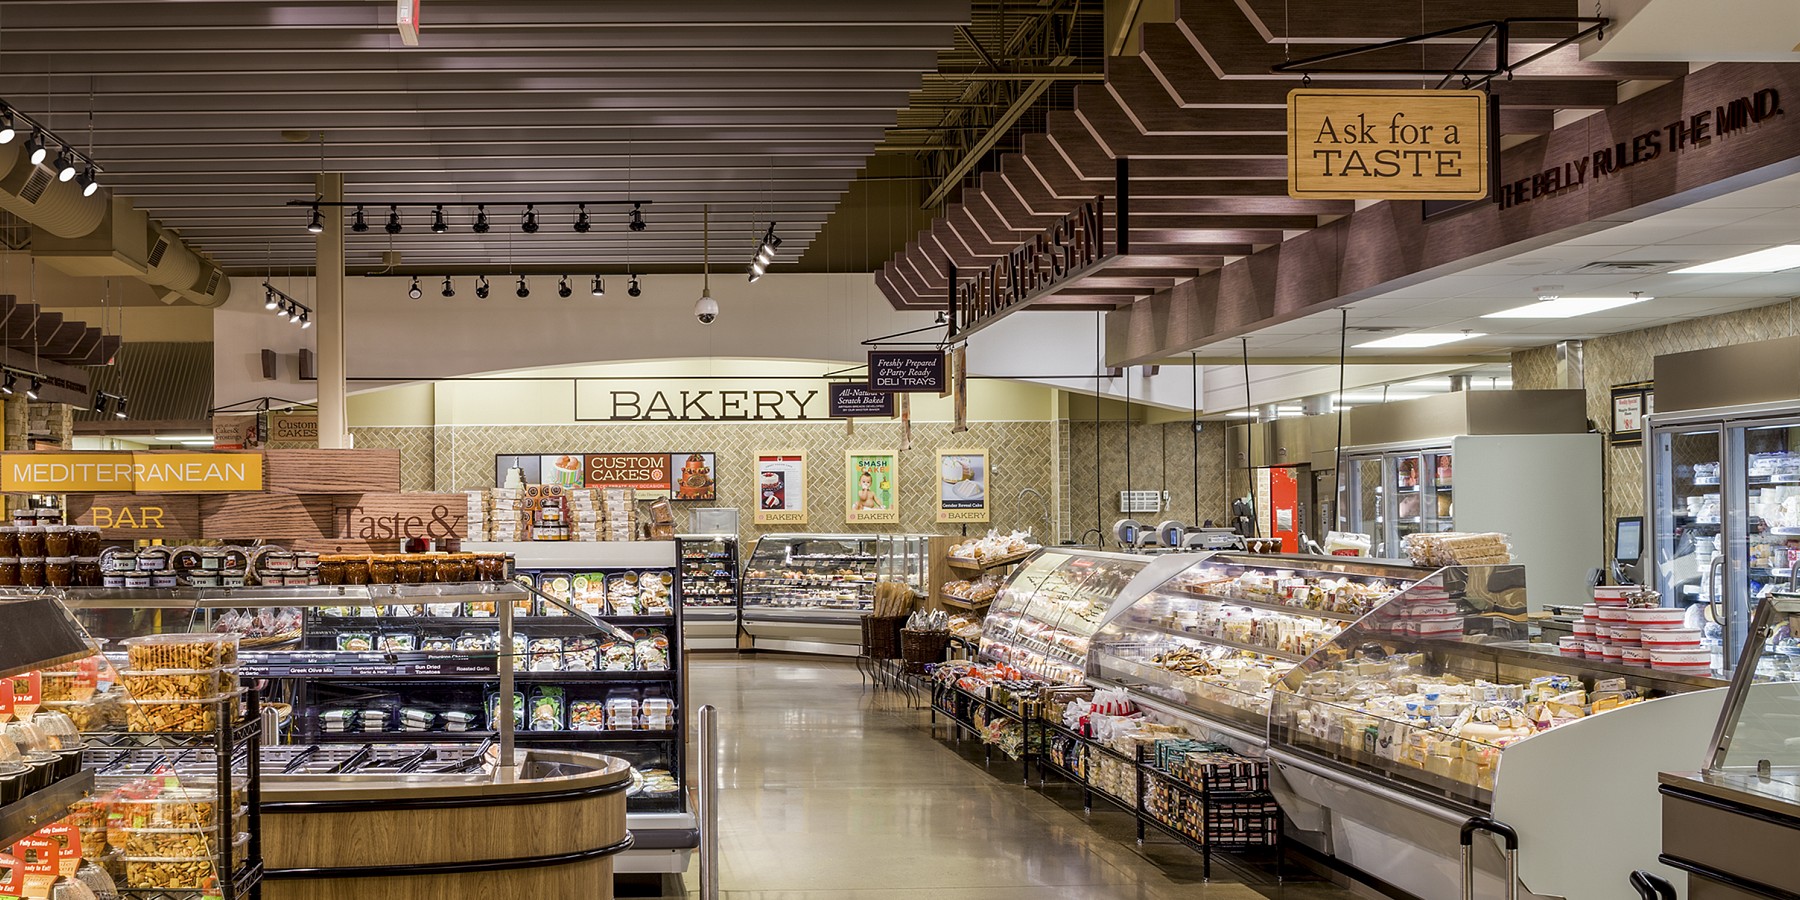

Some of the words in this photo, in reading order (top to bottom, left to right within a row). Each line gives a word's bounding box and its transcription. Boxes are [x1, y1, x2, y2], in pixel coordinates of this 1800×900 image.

[1314, 116, 1376, 144] Ask
[1388, 113, 1434, 144] for
[1445, 124, 1461, 145] a
[1499, 177, 1531, 211] THE
[1532, 156, 1589, 197] BELLY
[1593, 129, 1660, 179] RULES
[1664, 110, 1712, 153] THE
[1716, 88, 1785, 136] MIND.
[1313, 149, 1462, 177] TASTE
[959, 195, 1105, 330] DELICATESSEN
[877, 359, 904, 369] Freshly
[905, 358, 937, 370] Prepared
[908, 367, 932, 378] Ready
[877, 377, 900, 386] DELI
[901, 377, 936, 386] TRAYS
[609, 390, 819, 420] BAKERY
[837, 396, 861, 405] Scratch
[862, 396, 884, 405] Baked
[277, 419, 318, 429] Custom
[277, 429, 318, 437] CAKES
[591, 456, 664, 469] CUSTOM
[13, 462, 246, 484] MEDITERRANEAN
[591, 469, 651, 481] CAKES
[91, 507, 165, 529] BAR
[765, 513, 804, 521] BAKERY
